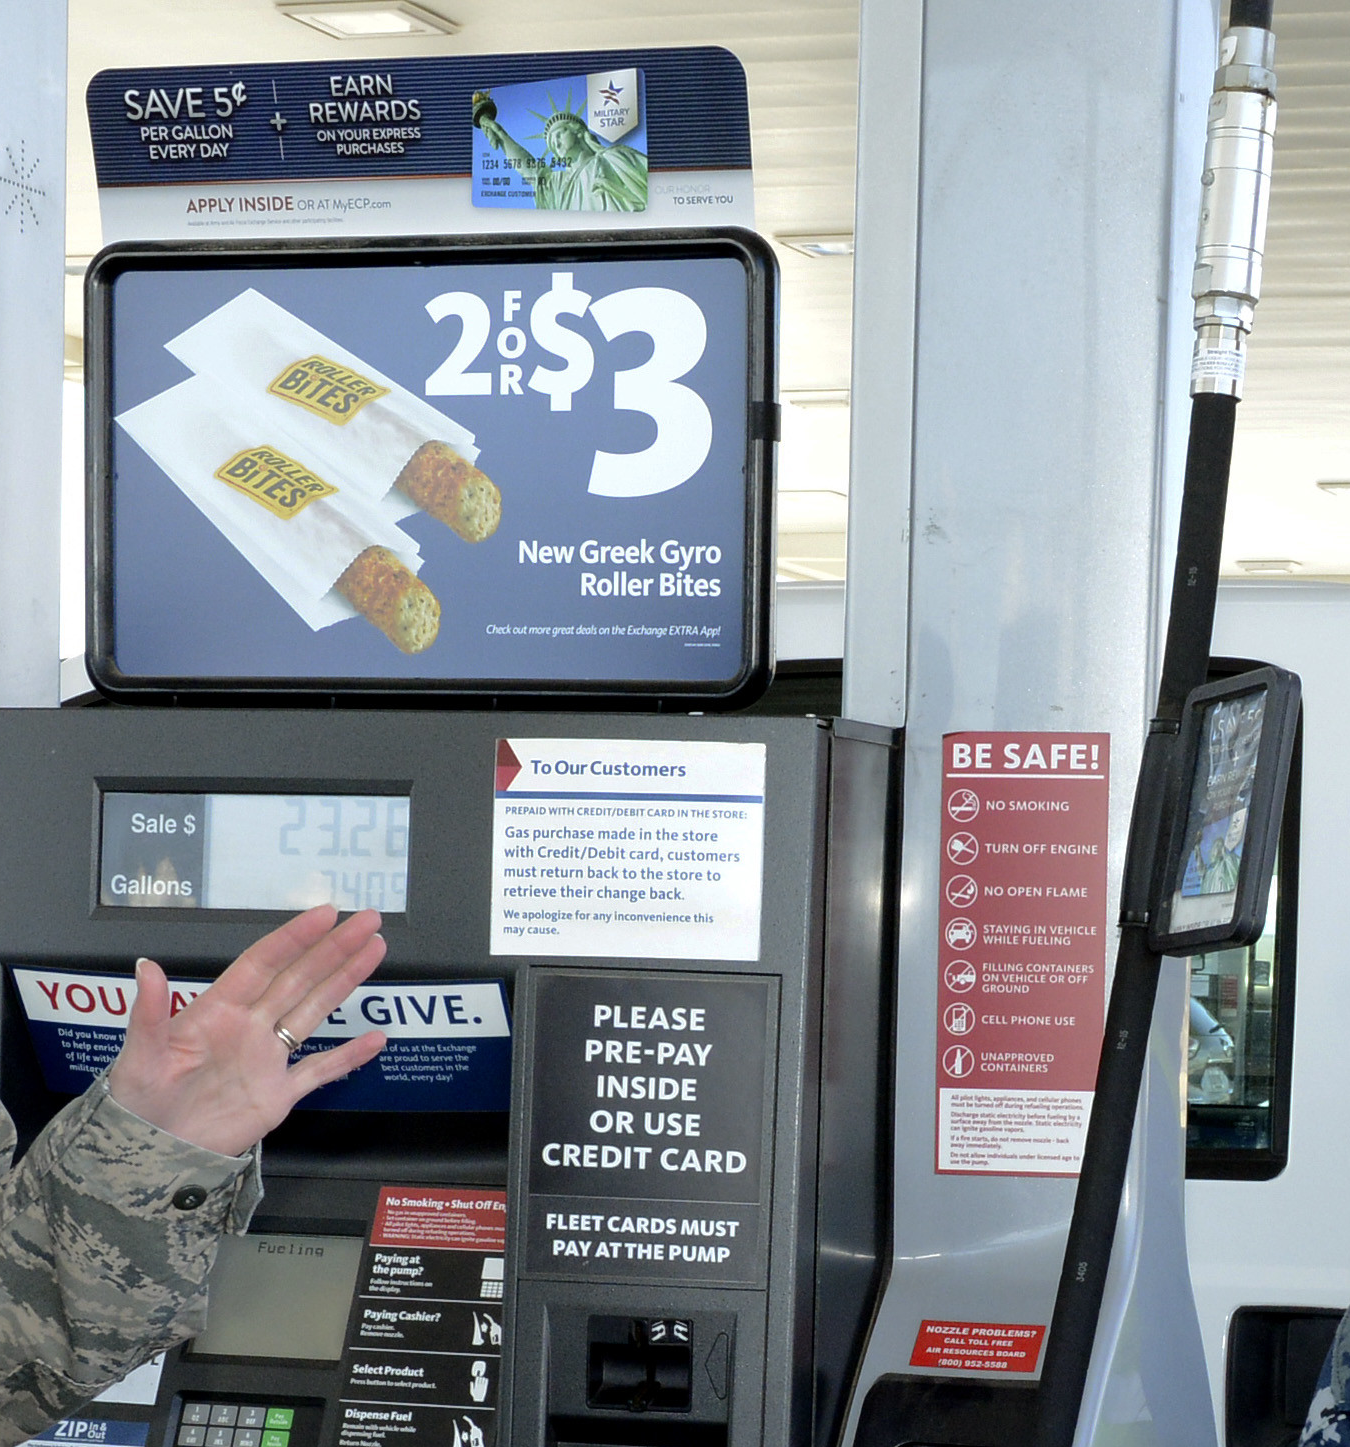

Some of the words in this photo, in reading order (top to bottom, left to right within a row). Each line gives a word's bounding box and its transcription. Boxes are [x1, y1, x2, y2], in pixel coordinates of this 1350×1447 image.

[330, 74, 393, 97] EARN
[124, 87, 204, 121] SAVE
[309, 99, 421, 124] REWARDS
[594, 108, 629, 118] MILITARY
[599, 117, 625, 128] STAR
[140, 126, 169, 142] PER
[172, 124, 233, 140] GALLON
[317, 130, 336, 142] ON
[337, 129, 371, 141] YOUR
[372, 127, 421, 140] EXPRESS
[149, 143, 197, 160] EVERY
[201, 143, 230, 157] DAY
[337, 142, 405, 156] PURCHASES
[186, 197, 234, 214] APPLY
[239, 196, 294, 212] INSIDE
[297, 199, 315, 211] OR
[317, 199, 331, 210] AT
[333, 197, 391, 213] MyECP.com
[673, 196, 685, 205] TO
[686, 196, 713, 205] SERVE
[714, 195, 733, 204] YOU
[423, 290, 493, 397] 2
[301, 361, 377, 396] ROLLER
[519, 540, 574, 564] New
[580, 539, 655, 564] Greek
[660, 540, 721, 571] Gyro
[581, 571, 654, 596] Roller
[660, 572, 721, 596] Bites
[486, 624, 512, 635] Check
[513, 626, 527, 635] out
[529, 627, 551, 635] more
[552, 626, 574, 637] great
[576, 625, 597, 635] deals
[599, 627, 610, 635] on
[612, 625, 625, 635] the
[627, 625, 667, 638] Exchange
[669, 625, 698, 635] EXTRA
[700, 626, 721, 638] App!
[953, 743, 992, 769] BE
[1003, 744, 1099, 770] SAFE!
[531, 760, 551, 774] To
[555, 760, 588, 775] Our
[591, 761, 686, 777] Customers
[505, 807, 546, 815] PREPAID
[549, 807, 574, 816] WITH
[577, 807, 645, 817] CREDIT/DEBIT
[647, 809, 675, 817] CARD
[677, 809, 688, 818] IN
[690, 810, 710, 818] THE
[712, 810, 748, 819] STORE:
[986, 801, 1006, 811] NO
[1009, 801, 1070, 812] SMOKING
[131, 813, 177, 834] Sale
[183, 814, 196, 836] $
[505, 827, 529, 838] Gas
[533, 827, 594, 841] purchase
[598, 828, 635, 840] made
[639, 828, 652, 840] in
[656, 829, 678, 840] the
[682, 831, 718, 841] store
[504, 846, 534, 858] with
[538, 846, 625, 860] Credit/Debit
[629, 848, 664, 862] card,
[667, 850, 740, 862] customers
[985, 843, 1019, 854] TURN
[1023, 844, 1046, 854] OFF
[1050, 844, 1098, 855] ENGINE
[504, 867, 536, 877] must
[541, 868, 583, 878] return
[587, 867, 618, 879] back
[623, 868, 637, 879] to
[641, 868, 663, 880] the
[667, 870, 703, 880] store
[707, 871, 721, 881] to
[110, 874, 193, 896] Gallons
[984, 886, 1004, 896] NO
[1007, 887, 1042, 897] OPEN
[1046, 887, 1087, 897] FLAME
[504, 885, 556, 897] retrieve
[560, 886, 593, 898] their
[597, 886, 646, 902] change
[649, 887, 684, 900] back.
[983, 925, 1030, 934] STAYING
[1034, 925, 1046, 935] IN
[1049, 925, 1097, 935] VEHICLE
[983, 935, 1019, 944] WHILE
[1022, 936, 1071, 946] FUELING
[982, 963, 1023, 972] FILLING
[1026, 964, 1095, 973] CONTAINERS
[982, 973, 999, 982] ON
[1002, 974, 1046, 984] VEHICLE
[1049, 974, 1065, 984] OR
[1067, 975, 1089, 984] OFF
[982, 984, 1030, 994] GROUND
[36, 981, 127, 1016] YOU
[360, 995, 483, 1026] GIVE.
[594, 1005, 706, 1031] PLEASE
[981, 1015, 1008, 1025] CELL
[1011, 1016, 1051, 1026] PHONE
[1054, 1016, 1076, 1026] USE
[585, 1039, 713, 1066] PRE-PAY
[981, 1052, 1054, 1062] UNAPPROVED
[980, 1063, 1048, 1073] CONTAINERS
[597, 1075, 697, 1101] INSIDE
[589, 1110, 634, 1134] OR
[644, 1111, 701, 1136] USE
[542, 1143, 652, 1170] CREDIT
[660, 1148, 747, 1173] CARD
[546, 1213, 604, 1231] FLEET
[607, 1216, 677, 1235] CARDS
[680, 1220, 739, 1237] MUST
[258, 1242, 324, 1257] Fueling
[552, 1240, 592, 1257] PAY
[594, 1242, 622, 1258] AT
[624, 1243, 664, 1260] THE
[669, 1245, 731, 1263] PUMP
[926, 1325, 969, 1335] NOZZLE
[972, 1328, 1037, 1338] PROBLEMS?
[353, 1364, 384, 1375] Select
[385, 1366, 424, 1377] Product
[345, 1409, 390, 1421] Dispense
[391, 1411, 412, 1421] Fuel
[54, 1420, 88, 1438] ZIP
